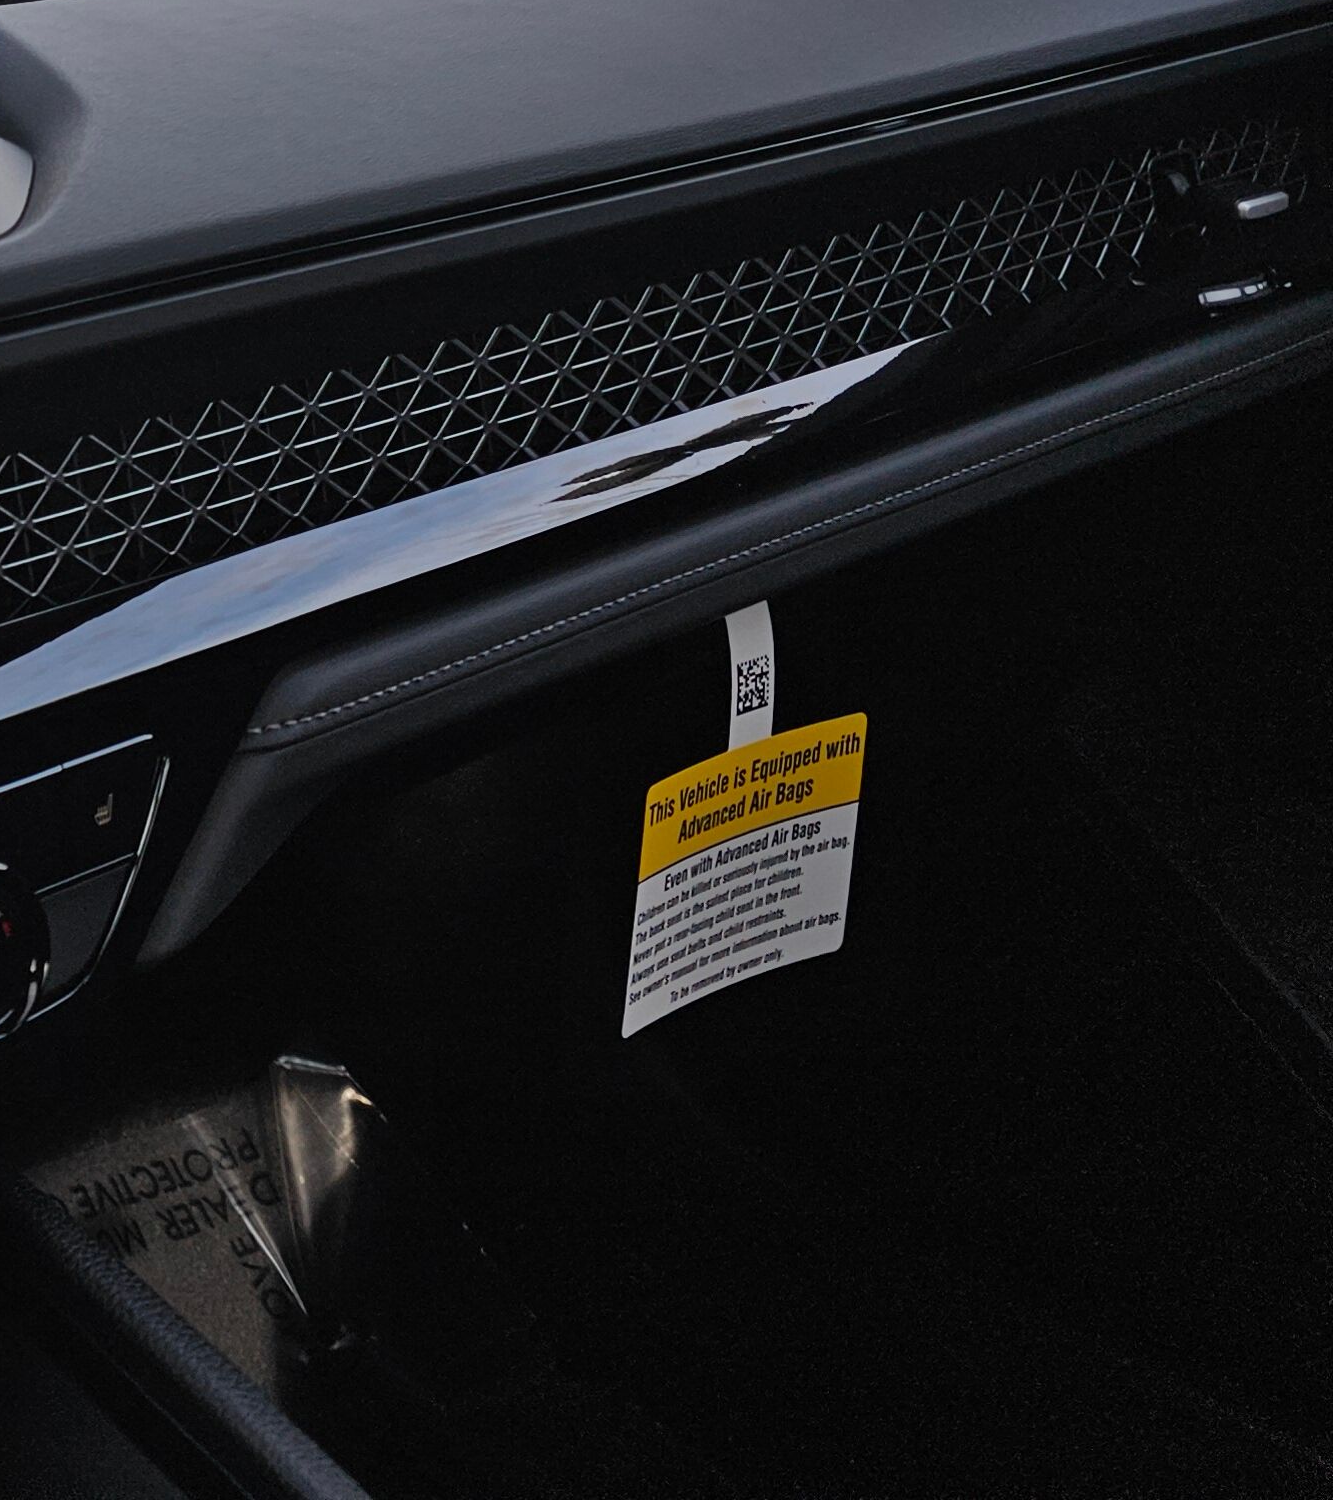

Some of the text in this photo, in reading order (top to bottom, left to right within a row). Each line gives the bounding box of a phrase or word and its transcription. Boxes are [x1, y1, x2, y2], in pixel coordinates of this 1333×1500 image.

[649, 732, 860, 828] This Vehicle is Equipped with
[678, 778, 814, 844] Advanced Air Bags
[637, 836, 850, 926] Children can be killed or seriously injured by the air bag.
[664, 821, 821, 892] Even with Advanced Air Bags
[633, 946, 654, 966] Never
[654, 937, 666, 955] put
[666, 936, 673, 946] a
[715, 906, 735, 924] child
[736, 900, 754, 916] seat
[755, 896, 764, 908] in
[765, 891, 778, 905] the
[780, 883, 802, 900] front.
[636, 867, 804, 946] The back seat is the safest place for children.
[628, 911, 842, 1006] See owner's manual for more information about air bags.
[631, 908, 786, 987] Always use seat belts and child restraints.
[670, 947, 784, 1003] To be removed by owner only.
[69, 1125, 261, 1220] PROTECTIVE
